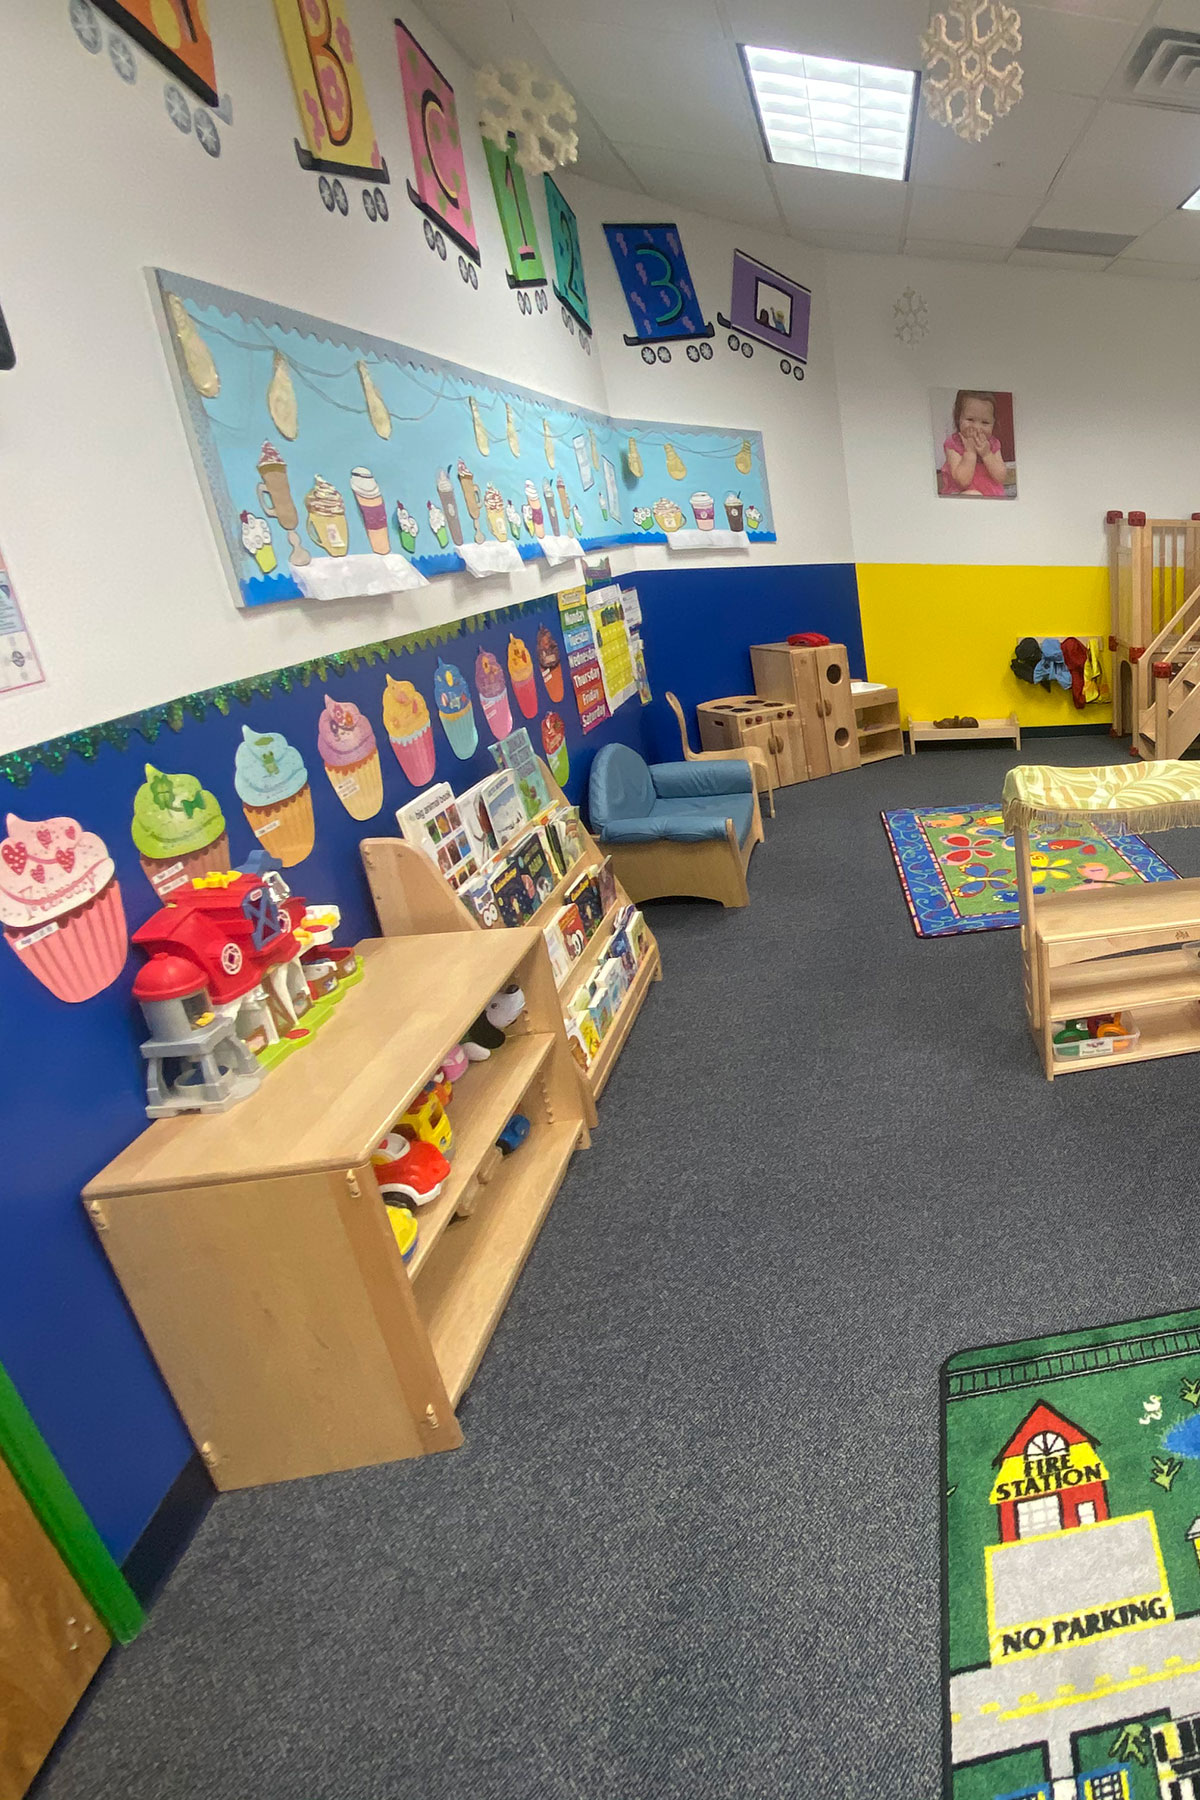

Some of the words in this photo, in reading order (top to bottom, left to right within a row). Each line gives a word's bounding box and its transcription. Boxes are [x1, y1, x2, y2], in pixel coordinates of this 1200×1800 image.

[422, 88, 460, 210] C
[505, 154, 537, 262] 1
[560, 210, 584, 304] 2
[635, 242, 683, 327] 3
[573, 667, 601, 688] Thursday
[582, 689, 599, 706] Friday
[582, 704, 607, 728] Saturday
[996, 1462, 1102, 1501] STATION
[1024, 1454, 1073, 1478] FIRE
[1002, 1627, 1046, 1656] NO
[1053, 1597, 1167, 1644] PARKING
